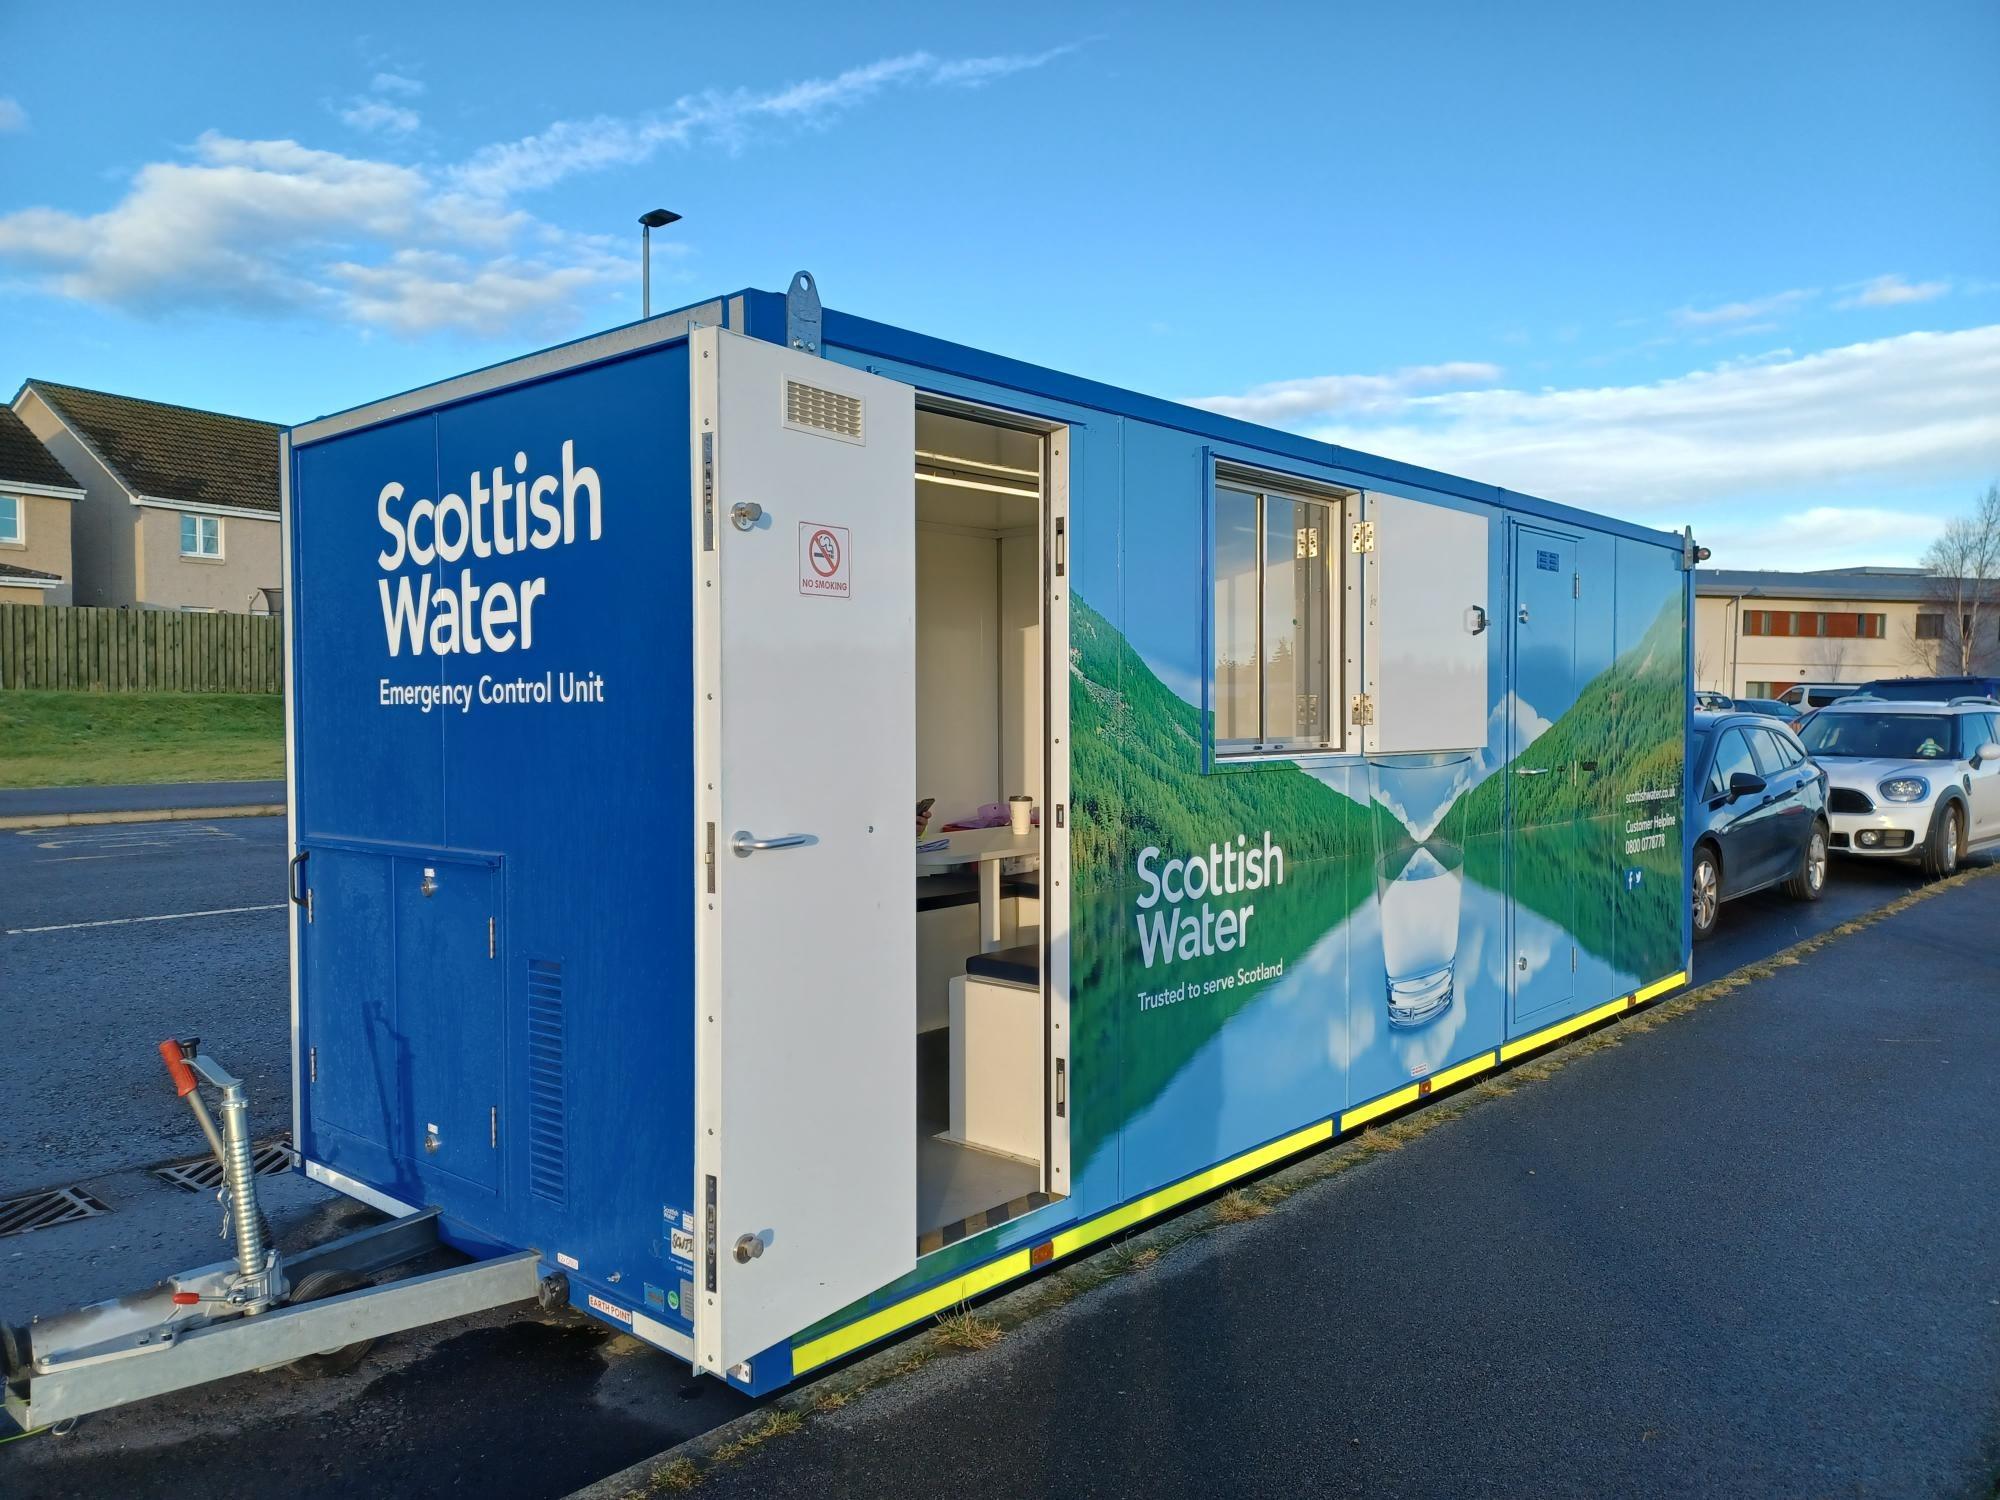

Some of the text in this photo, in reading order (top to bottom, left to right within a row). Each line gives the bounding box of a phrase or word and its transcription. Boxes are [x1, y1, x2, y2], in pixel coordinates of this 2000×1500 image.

[377, 439, 602, 571] Scottish
[802, 579, 847, 590] NO SMOKING
[378, 568, 546, 657] Water
[379, 671, 604, 713] Emergency Control Unit
[1625, 814, 1675, 833] Customer Helpline
[1626, 839, 1641, 854] 0800
[1136, 830, 1284, 909] Scottish
[1136, 902, 1255, 969] Water
[1137, 957, 1283, 1012] Trusted to serve Scotland
[590, 1296, 631, 1323] EARTH POINT
